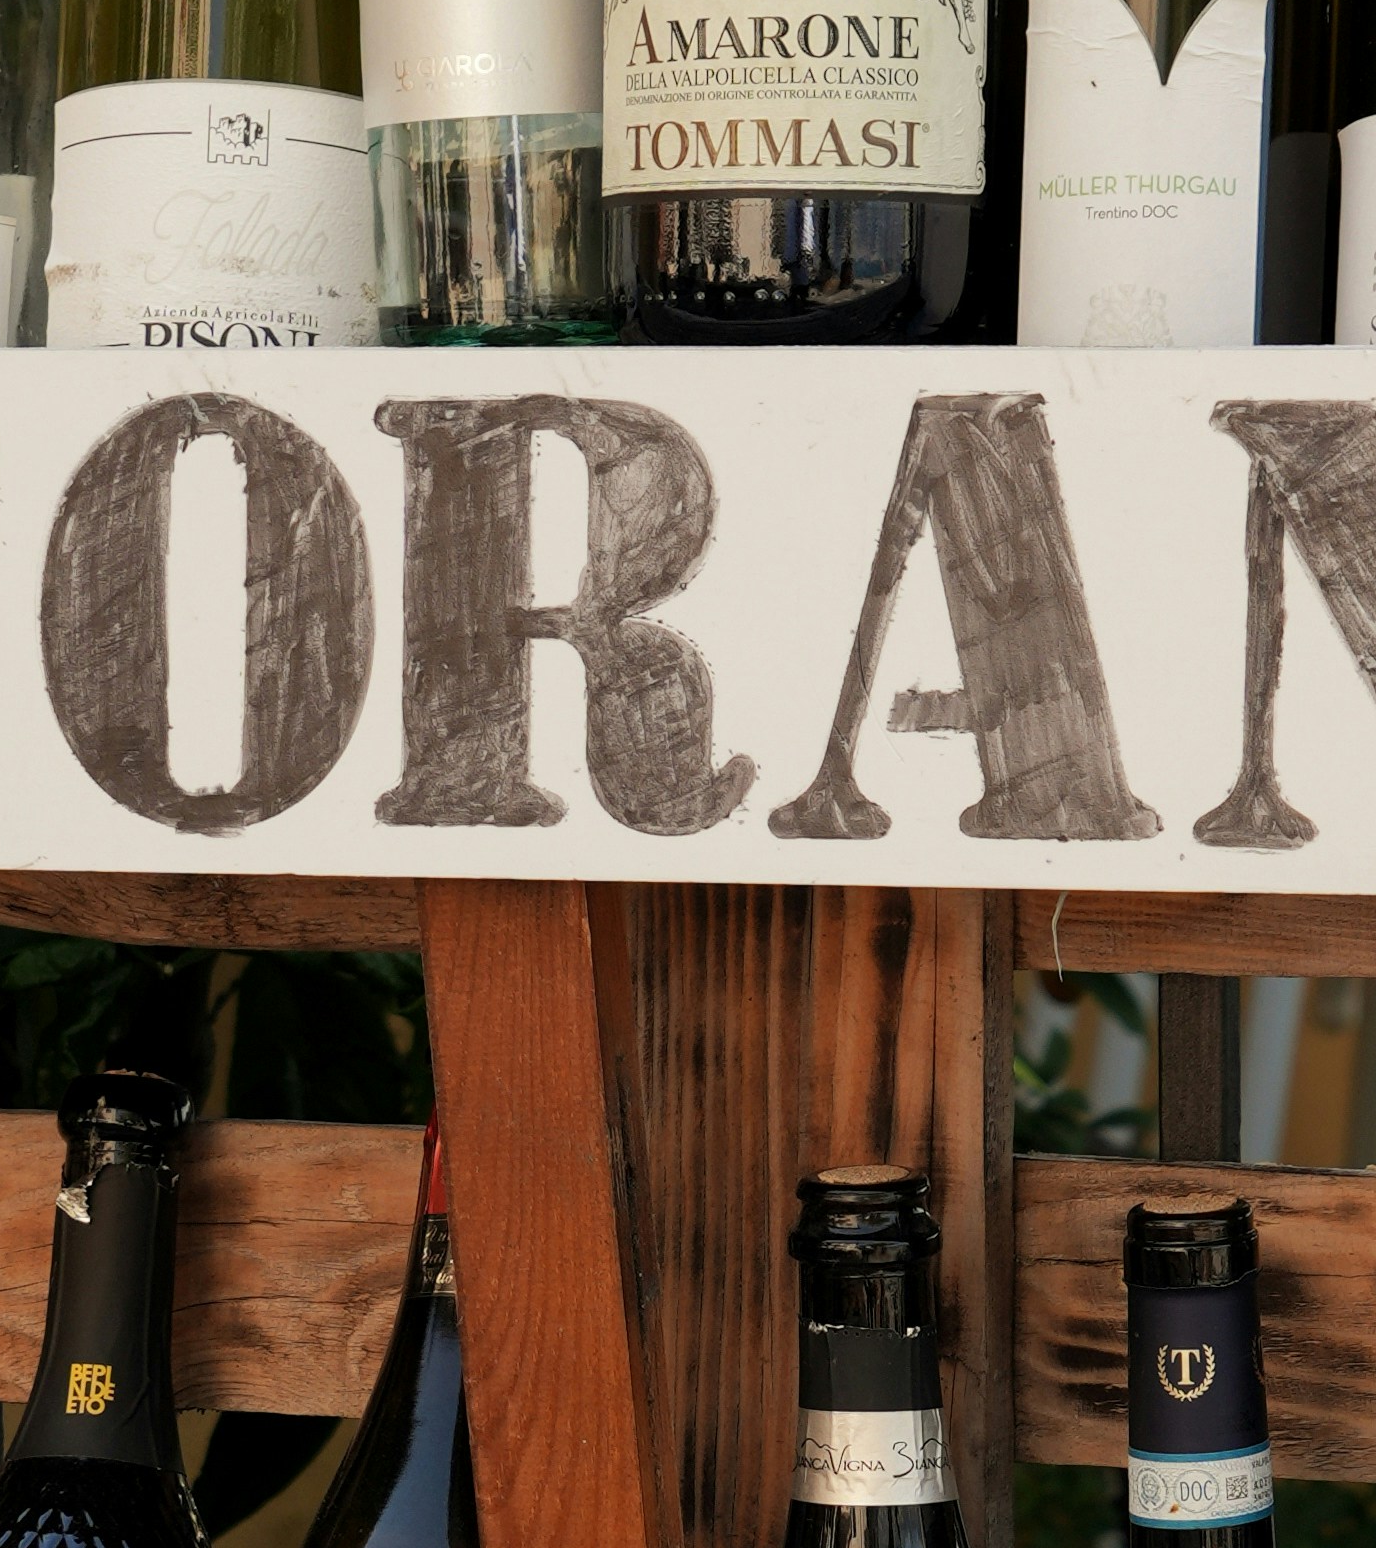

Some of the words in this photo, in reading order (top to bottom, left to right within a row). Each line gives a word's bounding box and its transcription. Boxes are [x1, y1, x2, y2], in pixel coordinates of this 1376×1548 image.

[625, 4, 920, 67] AMARONE
[625, 69, 668, 92] DELLA
[670, 66, 818, 91] VALPOLICELLA
[822, 66, 920, 92] CLASSICO
[625, 92, 693, 107] DENOMINAZIONE
[707, 90, 755, 102] ORIGINE
[756, 89, 842, 101] CONTROLLATA
[854, 91, 918, 104] GARANTITA
[624, 117, 923, 173] TOMMASI
[1038, 173, 1118, 201] MÜLLER
[1124, 174, 1238, 198] THURGAU
[1084, 206, 1139, 221] Trentino
[1141, 204, 1180, 220] DOC
[142, 305, 209, 319] Azienda
[214, 306, 285, 325] Agricola
[1170, 1348, 1201, 1387] T
[1179, 1479, 1213, 1502] DOC
